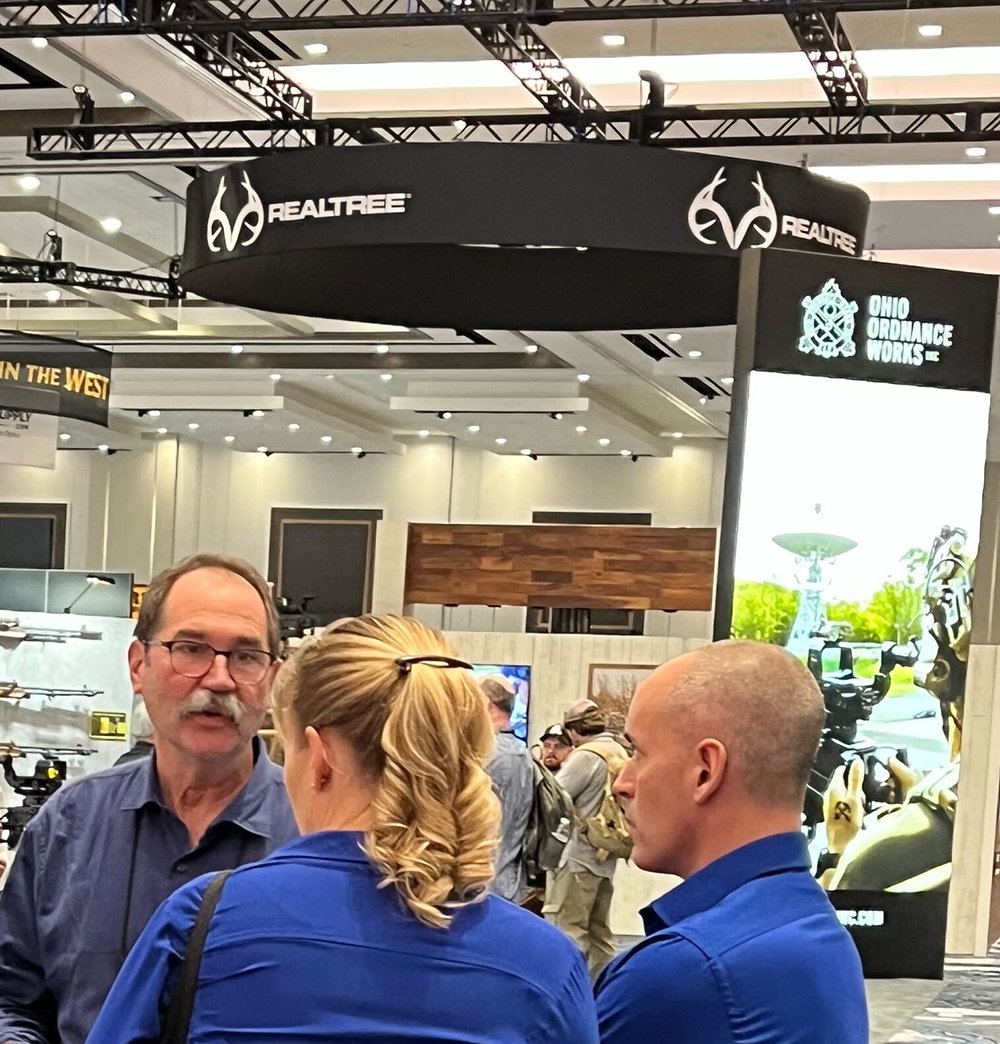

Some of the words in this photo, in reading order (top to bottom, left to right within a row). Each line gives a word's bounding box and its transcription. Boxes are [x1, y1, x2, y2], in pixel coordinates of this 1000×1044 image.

[267, 193, 406, 223] REALTREE
[868, 294, 910, 319] OHIO
[866, 317, 954, 347] ORDNANCE
[866, 339, 924, 366] WORKS
[26, 364, 61, 386] THE
[64, 366, 110, 400] WEST
